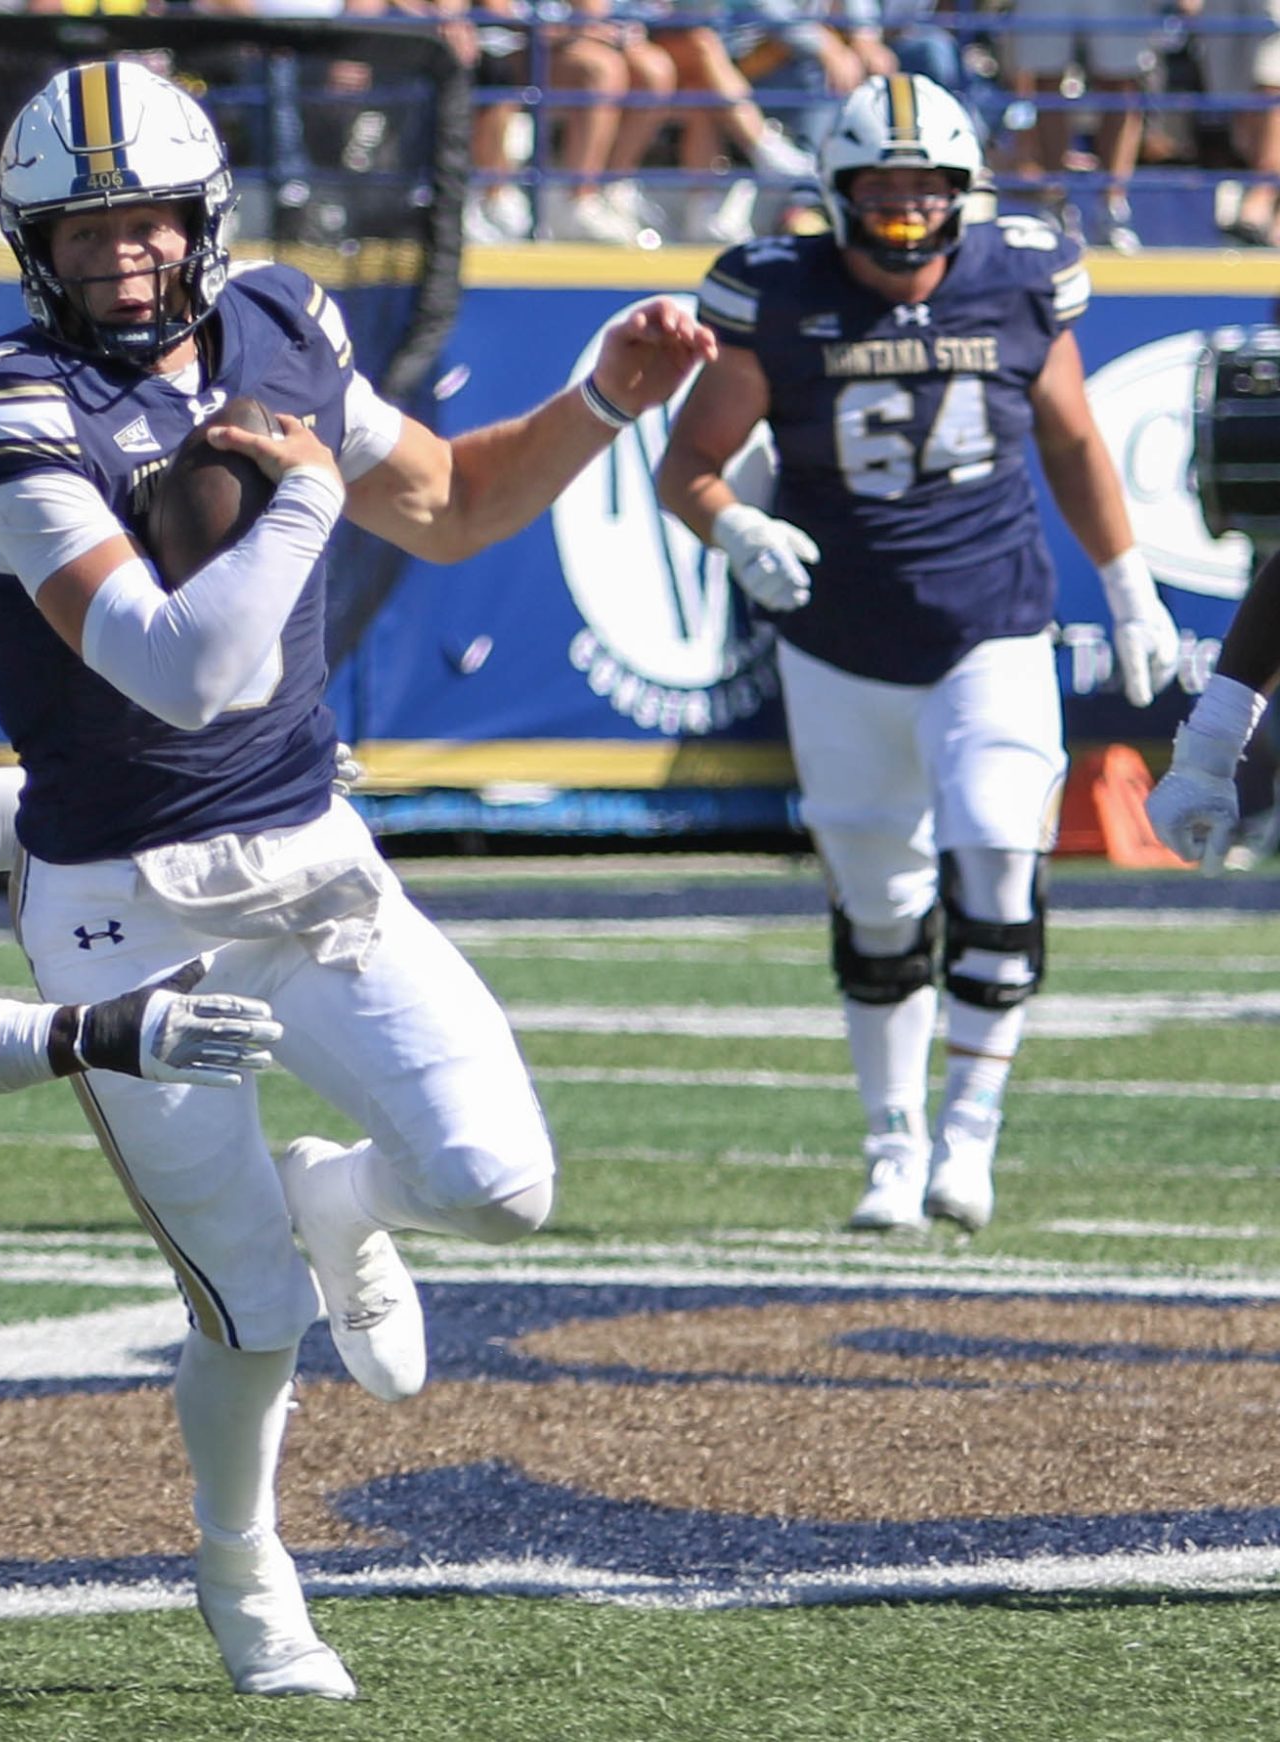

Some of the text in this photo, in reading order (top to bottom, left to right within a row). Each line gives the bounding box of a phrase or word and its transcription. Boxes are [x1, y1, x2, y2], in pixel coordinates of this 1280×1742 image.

[86, 171, 124, 190] 406
[824, 336, 1000, 376] MONTANA STATE
[835, 373, 998, 502] 64
